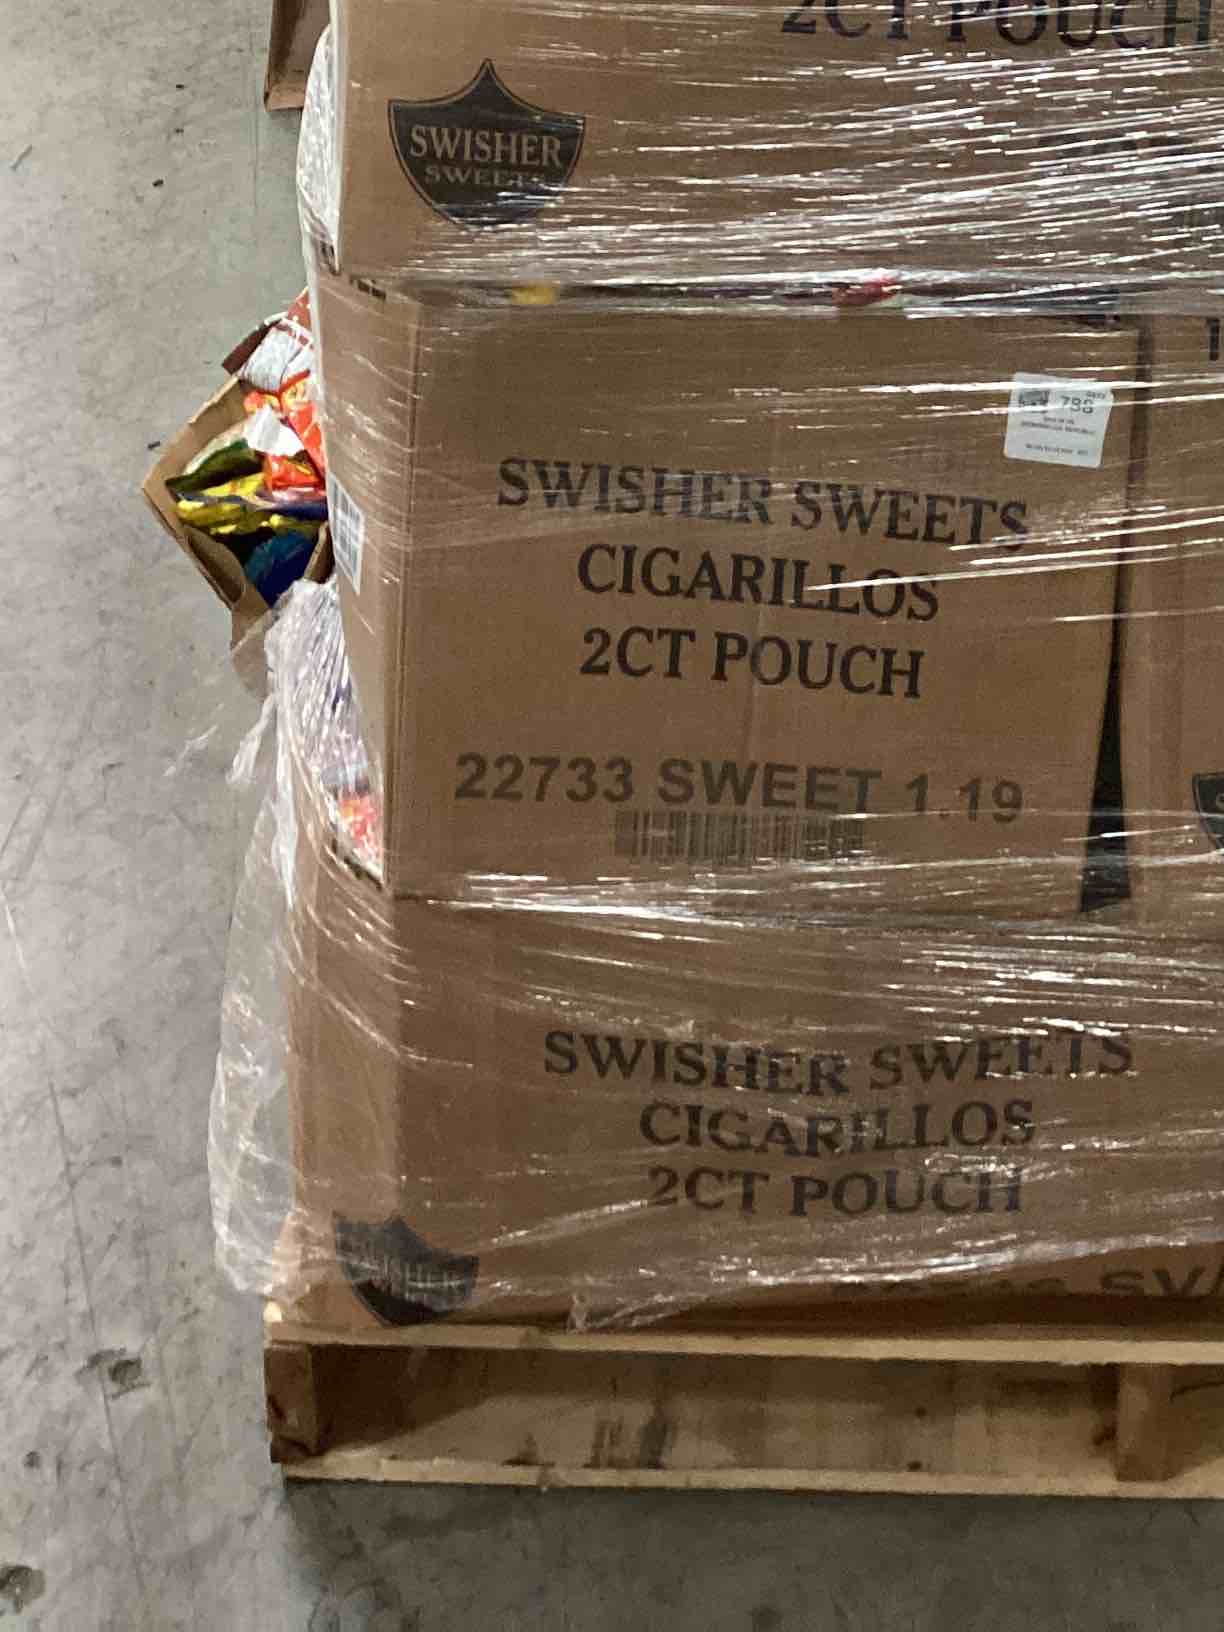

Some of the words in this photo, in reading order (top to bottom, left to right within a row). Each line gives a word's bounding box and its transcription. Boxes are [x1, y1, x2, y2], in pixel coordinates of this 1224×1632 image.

[408, 123, 563, 168] SWISHER
[424, 166, 547, 188] SWEETS
[499, 457, 775, 526] SWISHER
[790, 478, 1031, 552] SWEETS
[577, 543, 941, 623] CIGARILLOS
[579, 627, 697, 681] 2CT
[710, 631, 926, 699] POUCH
[454, 752, 635, 803] 22733
[656, 756, 882, 814] SWEET
[904, 772, 1026, 825] 1.19
[543, 1030, 851, 1097] SWISHER
[869, 1032, 1136, 1092] SWEETS
[638, 1098, 1037, 1158] CIGARILLOS
[647, 1167, 770, 1216] 2CT
[789, 1166, 1027, 1217] POUCH
